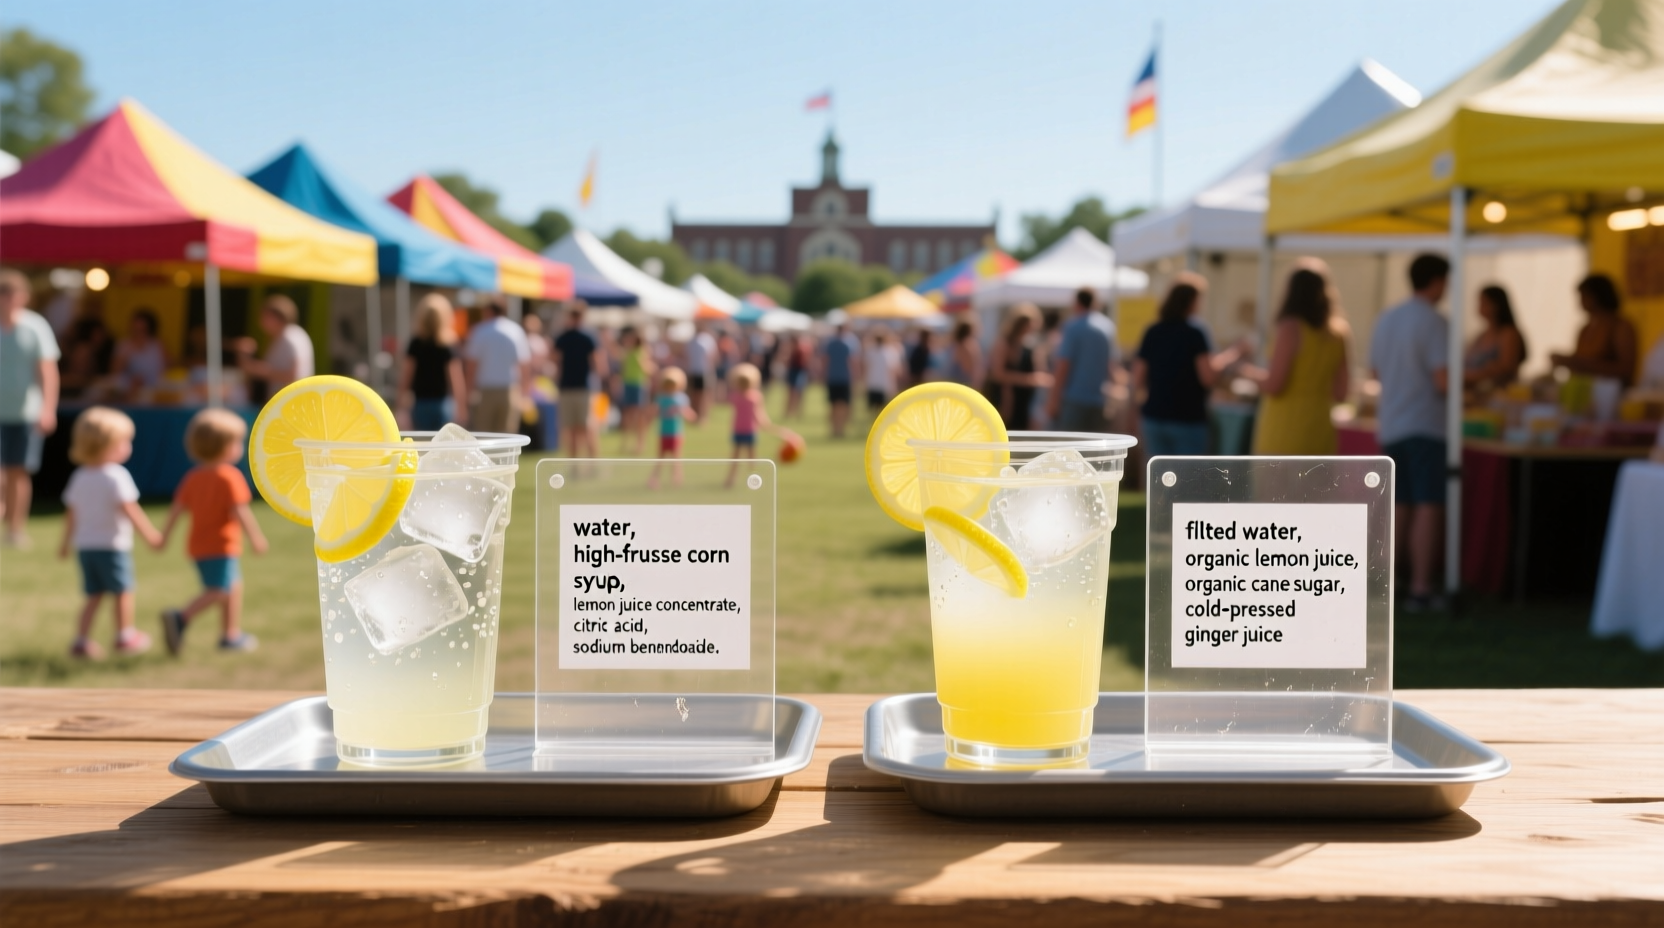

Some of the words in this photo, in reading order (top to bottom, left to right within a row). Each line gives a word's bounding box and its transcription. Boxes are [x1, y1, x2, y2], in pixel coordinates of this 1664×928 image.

[572, 518, 636, 541] water,
[1242, 522, 1302, 544] water,
[574, 542, 682, 569] high-frusse
[687, 549, 730, 564] corn
[1185, 548, 1250, 572] organic
[1255, 547, 1310, 567] lemon
[1312, 548, 1359, 573] juice,
[573, 574, 626, 595] syup,
[1184, 574, 1247, 597] organic
[1251, 578, 1291, 593] cane
[1293, 578, 1345, 597] sugar,
[573, 596, 616, 612] lemon
[618, 596, 653, 616] juice
[655, 597, 741, 615] concentrate,
[1185, 598, 1296, 623] cold-pressed
[573, 617, 608, 633] citric
[613, 617, 648, 636] acid,
[1184, 624, 1240, 648] ginger
[1241, 625, 1284, 648] juice
[572, 638, 626, 654] sodium
